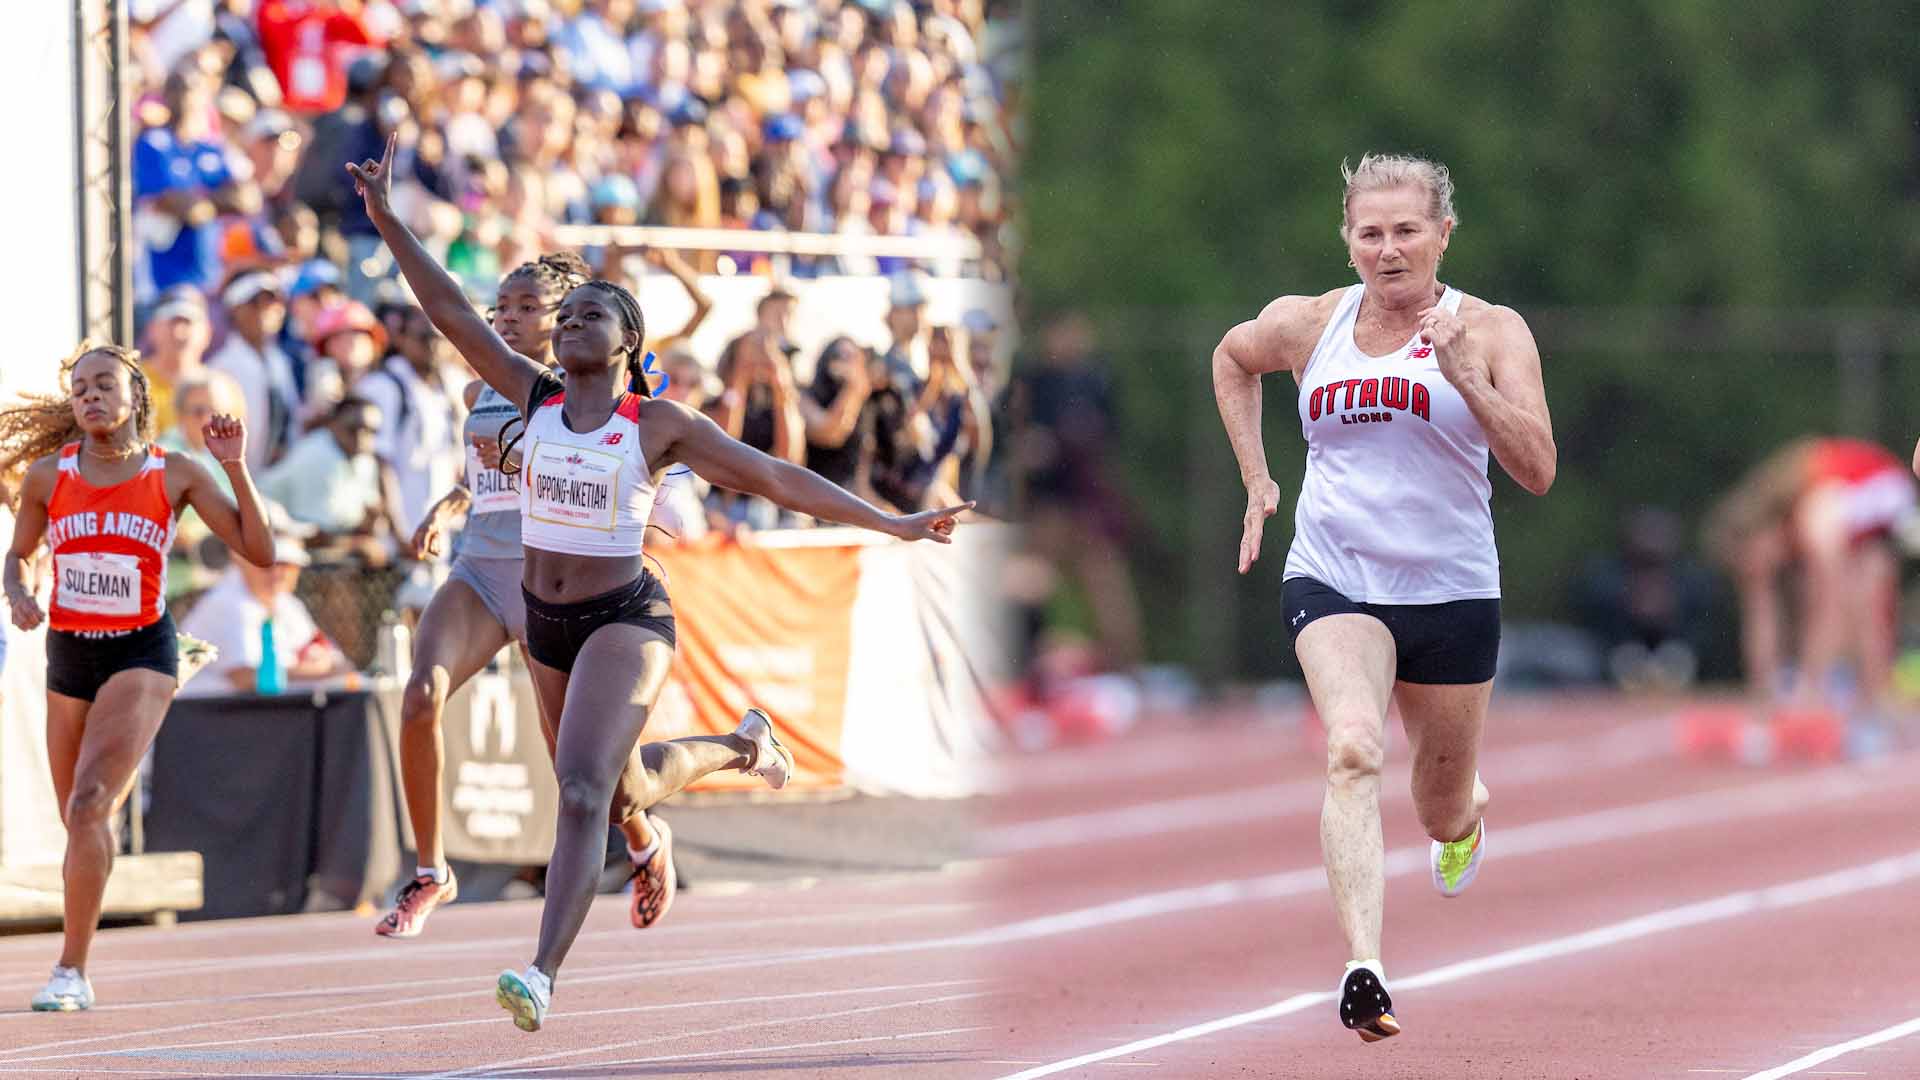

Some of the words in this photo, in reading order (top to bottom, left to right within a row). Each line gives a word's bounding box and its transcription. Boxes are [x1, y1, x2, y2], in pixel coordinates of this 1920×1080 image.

[1309, 376, 1431, 422] OTTAWA
[1341, 411, 1393, 425] LIONS
[477, 471, 521, 495] BAILE
[537, 473, 608, 510] OPPONG-NKETIAH
[65, 567, 131, 598] SULEMAN
